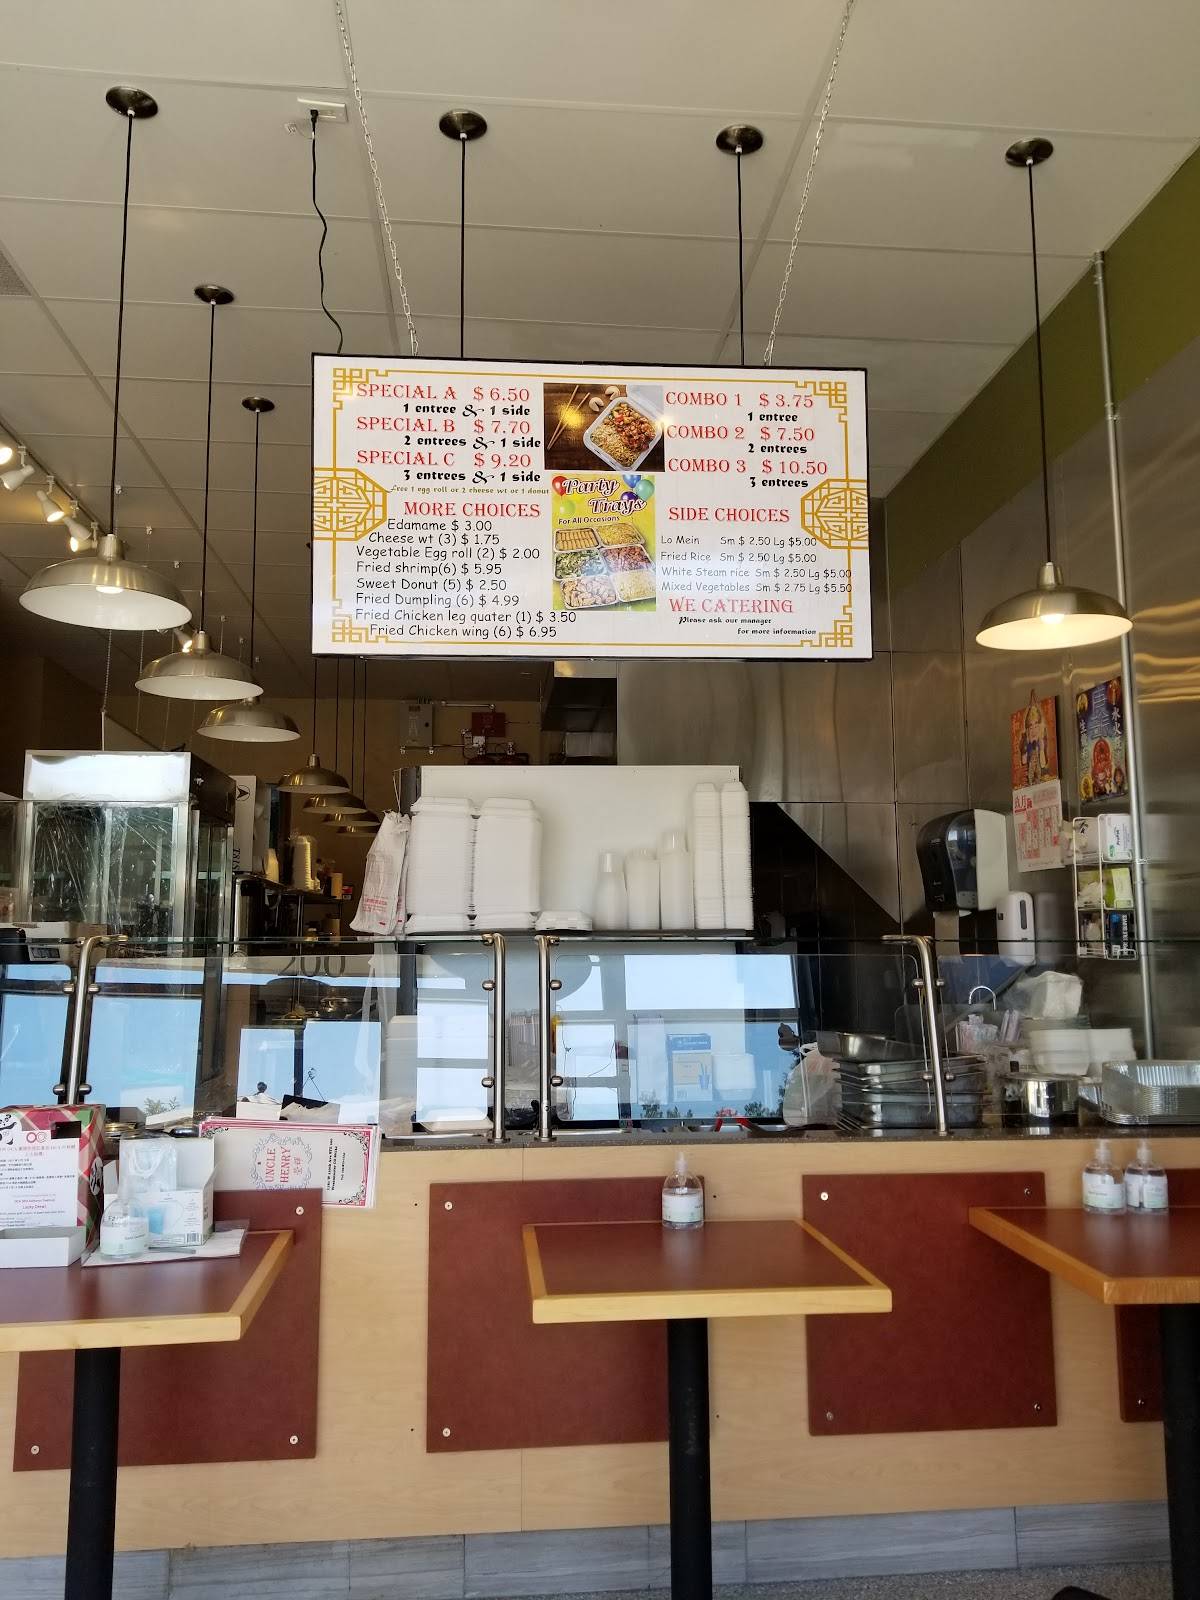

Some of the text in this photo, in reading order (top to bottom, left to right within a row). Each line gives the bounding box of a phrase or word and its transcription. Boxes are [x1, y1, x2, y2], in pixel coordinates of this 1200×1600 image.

[357, 384, 529, 401] SPECIAL A $ 6.50
[666, 392, 813, 408] COMBO 1 $ 3.75
[403, 403, 530, 417] 1 entree & 1 side
[748, 412, 797, 422] 1 entree
[357, 417, 530, 434] SPECIAL B $ 7.70
[667, 425, 814, 441] COMBO 2 $ 7.50
[404, 436, 541, 450] 2 entrees & 1 side
[748, 444, 807, 454] 2 entrees
[357, 451, 531, 468] SPECIAL C $ 9.20
[669, 459, 827, 475] COMBO 3 $ 10.50
[404, 470, 541, 484] 3 entrees & 1 side
[750, 477, 808, 488] 3 entrees
[562, 478, 619, 496] Party
[404, 502, 541, 517] MORE CHOICES
[589, 497, 646, 516] Trays
[669, 507, 790, 522] SIDE CHOICES
[387, 519, 492, 531] Edamame $ 3.00
[369, 532, 499, 546] Cheese wt (3) $ 1.75
[661, 536, 816, 548] Lo Mein Sm $ 2.50 Lg $5.00
[357, 546, 540, 560] Vegetable Egg roll (2) $ 2.00
[661, 552, 816, 564] Fried Rice Sm $ 2.50 Lg $5.00
[357, 561, 390, 572] Fried
[461, 563, 468, 574] $
[475, 564, 502, 574] 5.95
[662, 567, 692, 576] White
[697, 568, 726, 577] Steam
[756, 569, 770, 577] Sm
[774, 569, 780, 578] $
[784, 569, 805, 578] 2.50
[809, 570, 819, 579] Lg
[823, 570, 851, 578] $5.00
[357, 578, 506, 591] Sweet Donut (5) $ 2.50
[662, 582, 852, 594] Mixed Vegetables Sm $ 2.75 Lg $5.50
[356, 593, 519, 608] Fried Dumpling (6) $ 4.99
[670, 597, 794, 613] WE CATERING
[356, 609, 576, 624] Fried Chicken leg quater (1) $ 3.50
[678, 616, 705, 624] Please
[370, 624, 556, 638] Fried Chicken wing (6) $ 6.95
[265, 1148, 276, 1182] UNCLE
[280, 1146, 291, 1183] HENRY
